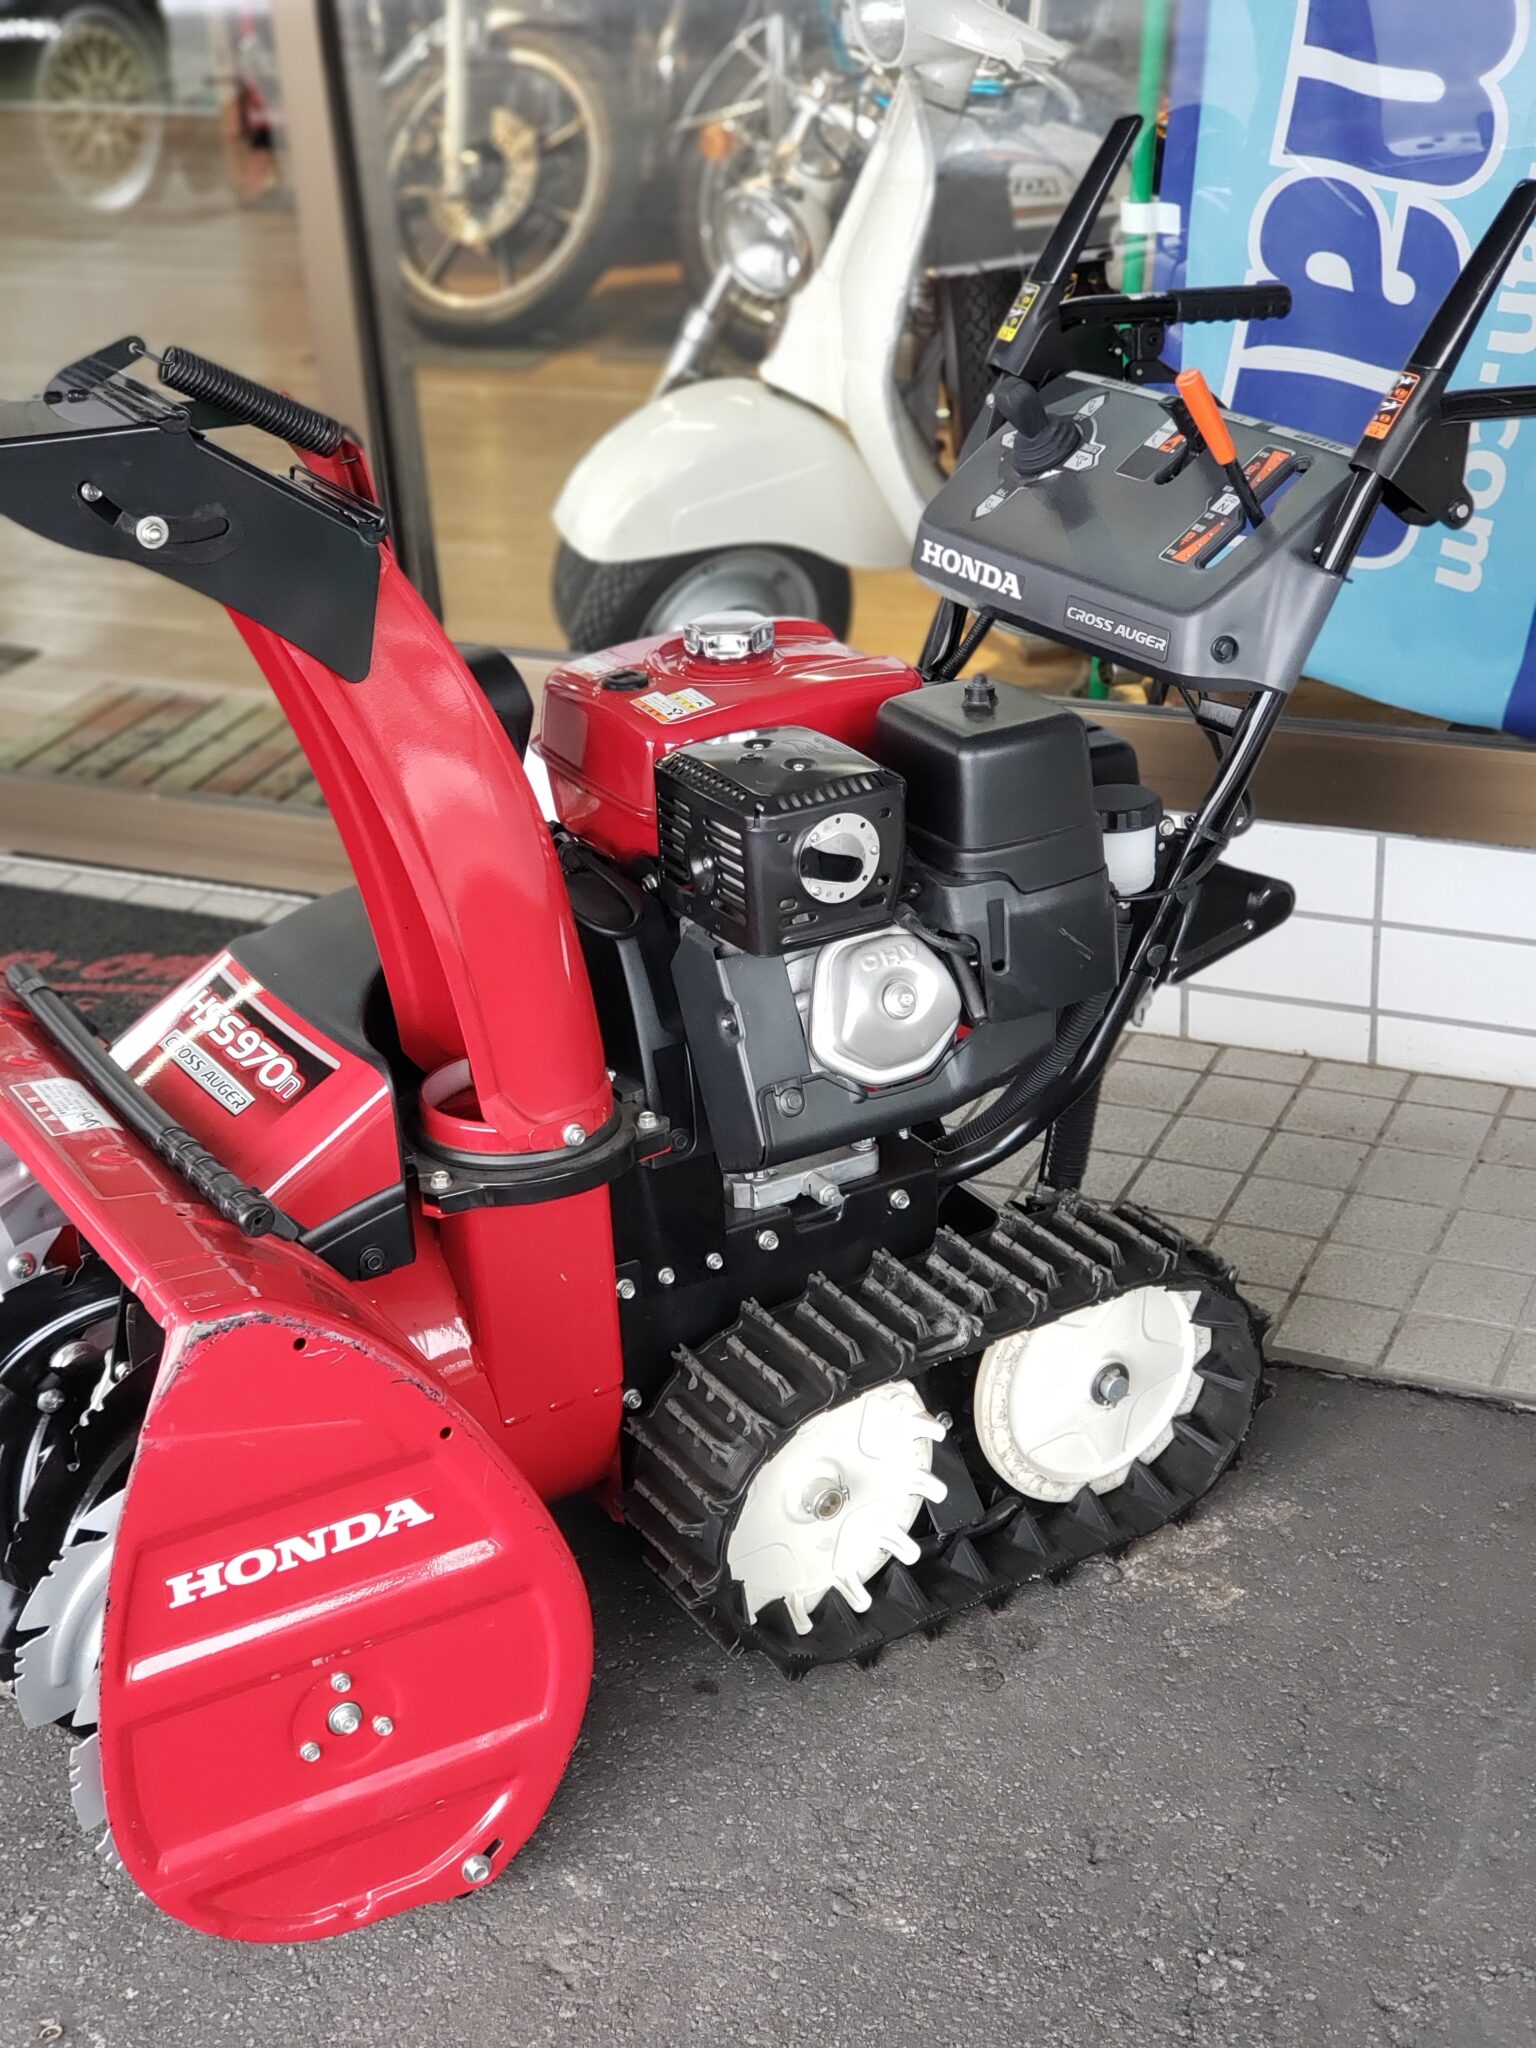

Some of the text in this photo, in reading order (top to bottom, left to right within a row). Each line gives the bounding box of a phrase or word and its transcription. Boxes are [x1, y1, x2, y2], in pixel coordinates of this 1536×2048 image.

[920, 539, 1022, 600] HONDA
[1066, 605, 1167, 652] CROSS AUGER
[861, 941, 918, 973] OHV
[164, 1035, 247, 1111] COSS AUGER
[181, 987, 304, 1101] HSS970n
[165, 1498, 435, 1609] HONDA
